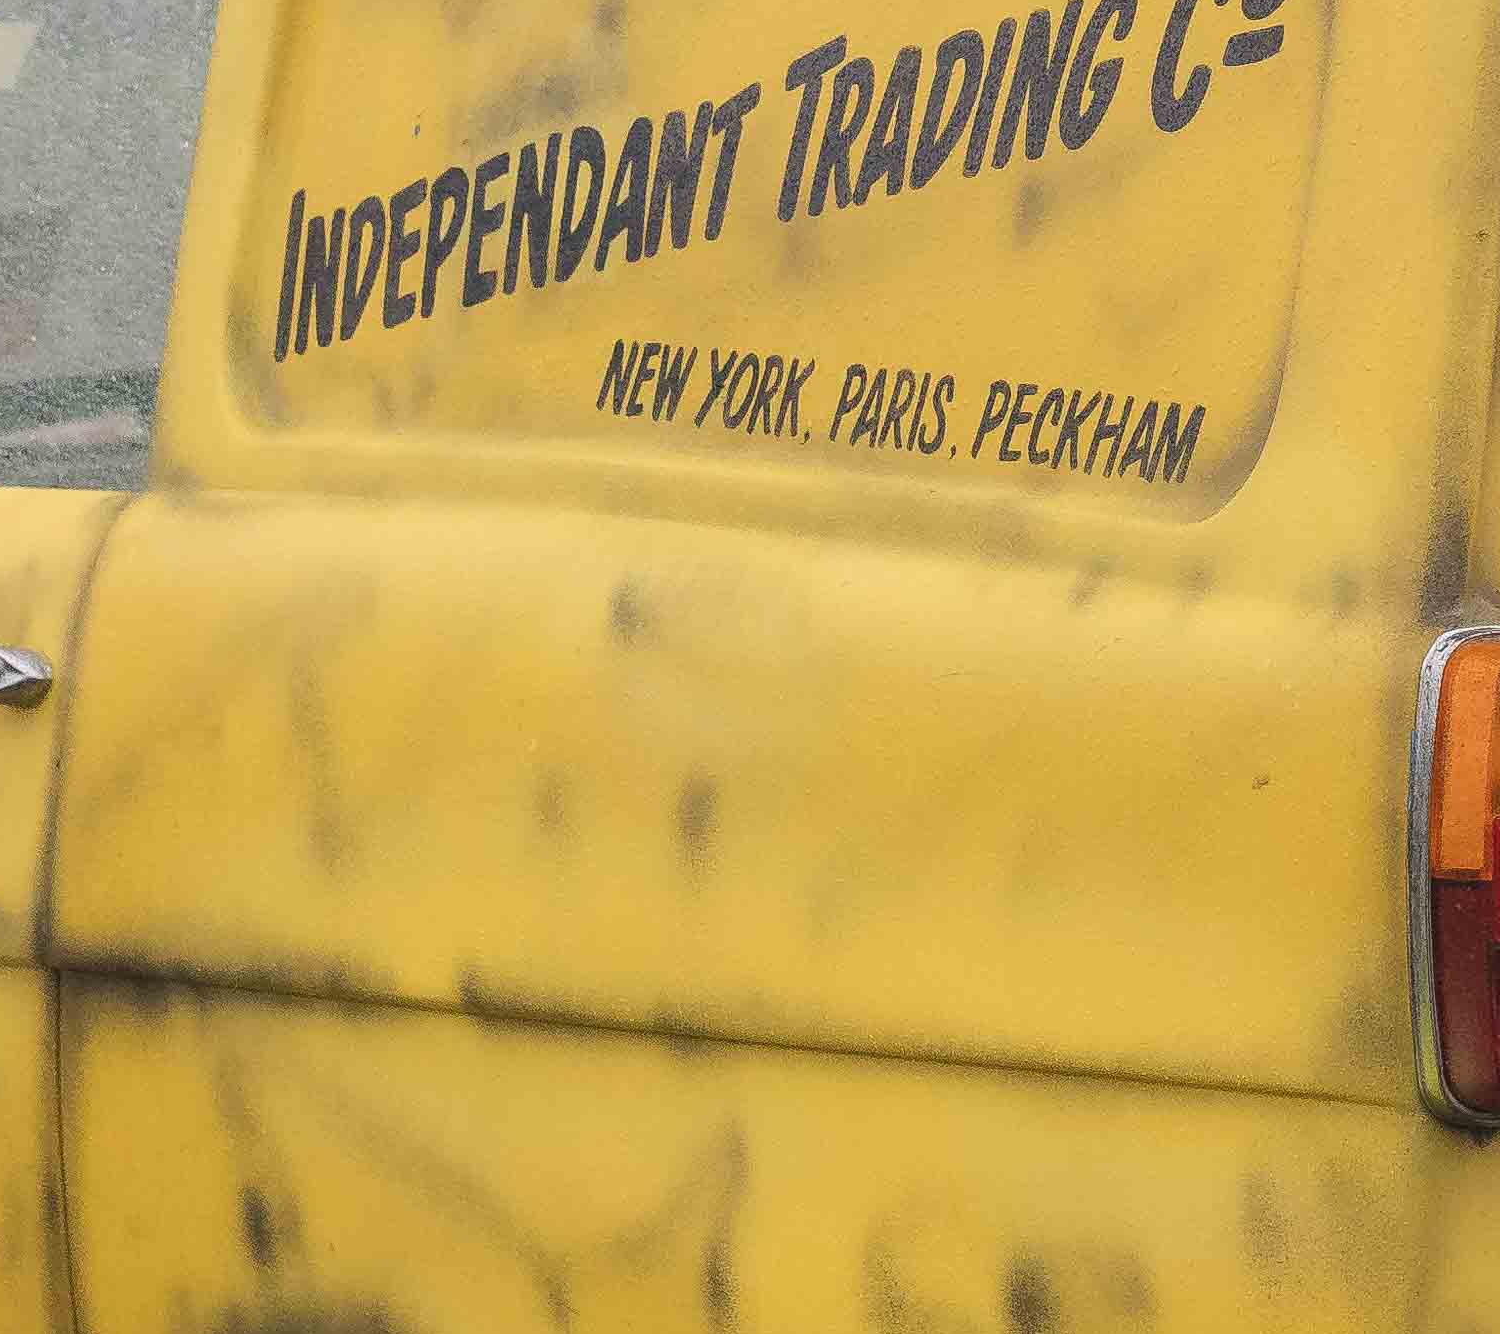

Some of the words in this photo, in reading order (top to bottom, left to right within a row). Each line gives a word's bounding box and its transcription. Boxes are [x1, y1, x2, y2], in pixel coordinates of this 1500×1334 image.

[274, 82, 761, 362] INDEPENDANT
[596, 338, 697, 422] NEW
[970, 380, 1205, 482] PECKHAM
